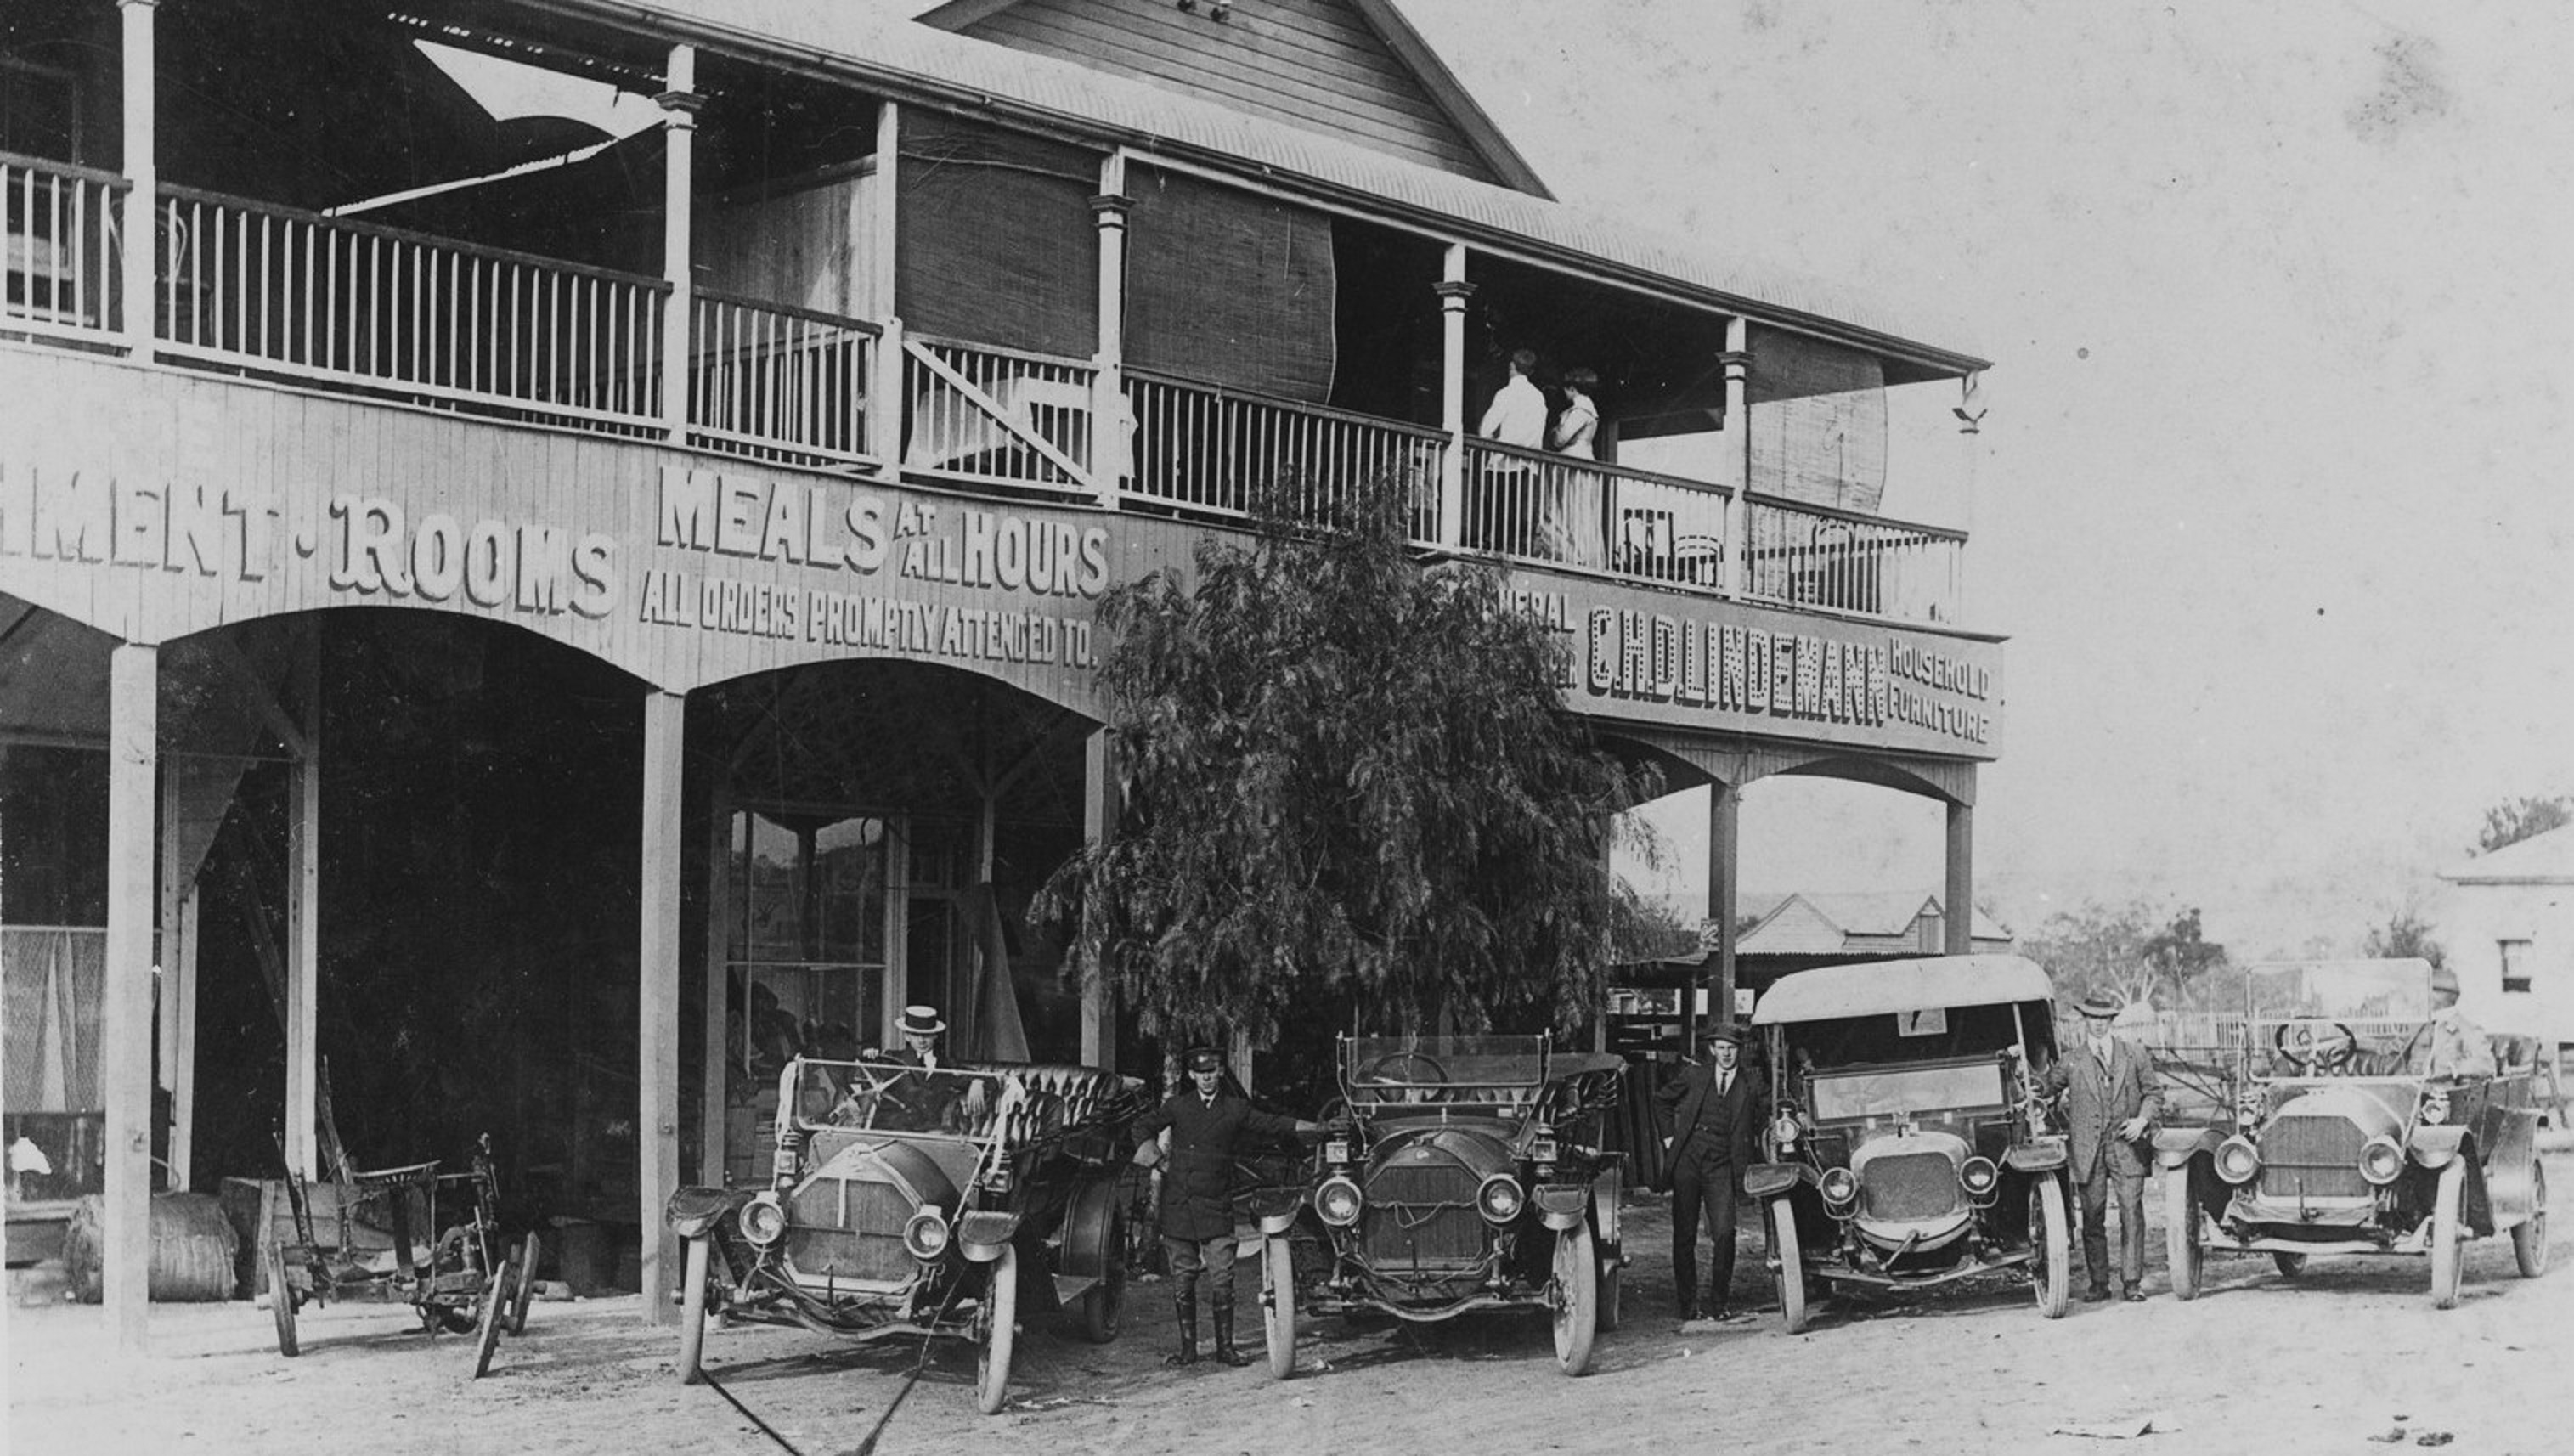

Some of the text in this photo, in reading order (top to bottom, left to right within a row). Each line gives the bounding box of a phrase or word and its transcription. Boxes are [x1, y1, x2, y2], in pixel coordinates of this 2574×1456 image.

[0, 460, 622, 620] MENT ROOMS
[657, 465, 1109, 600] MEALS AT ALL HOURS
[639, 570, 1098, 670] ALL ORDERS PROMPTLY ATTENDED TO.
[1889, 636, 1989, 702] HOUSEHOLD
[1887, 680, 1990, 745] FURNITURE
